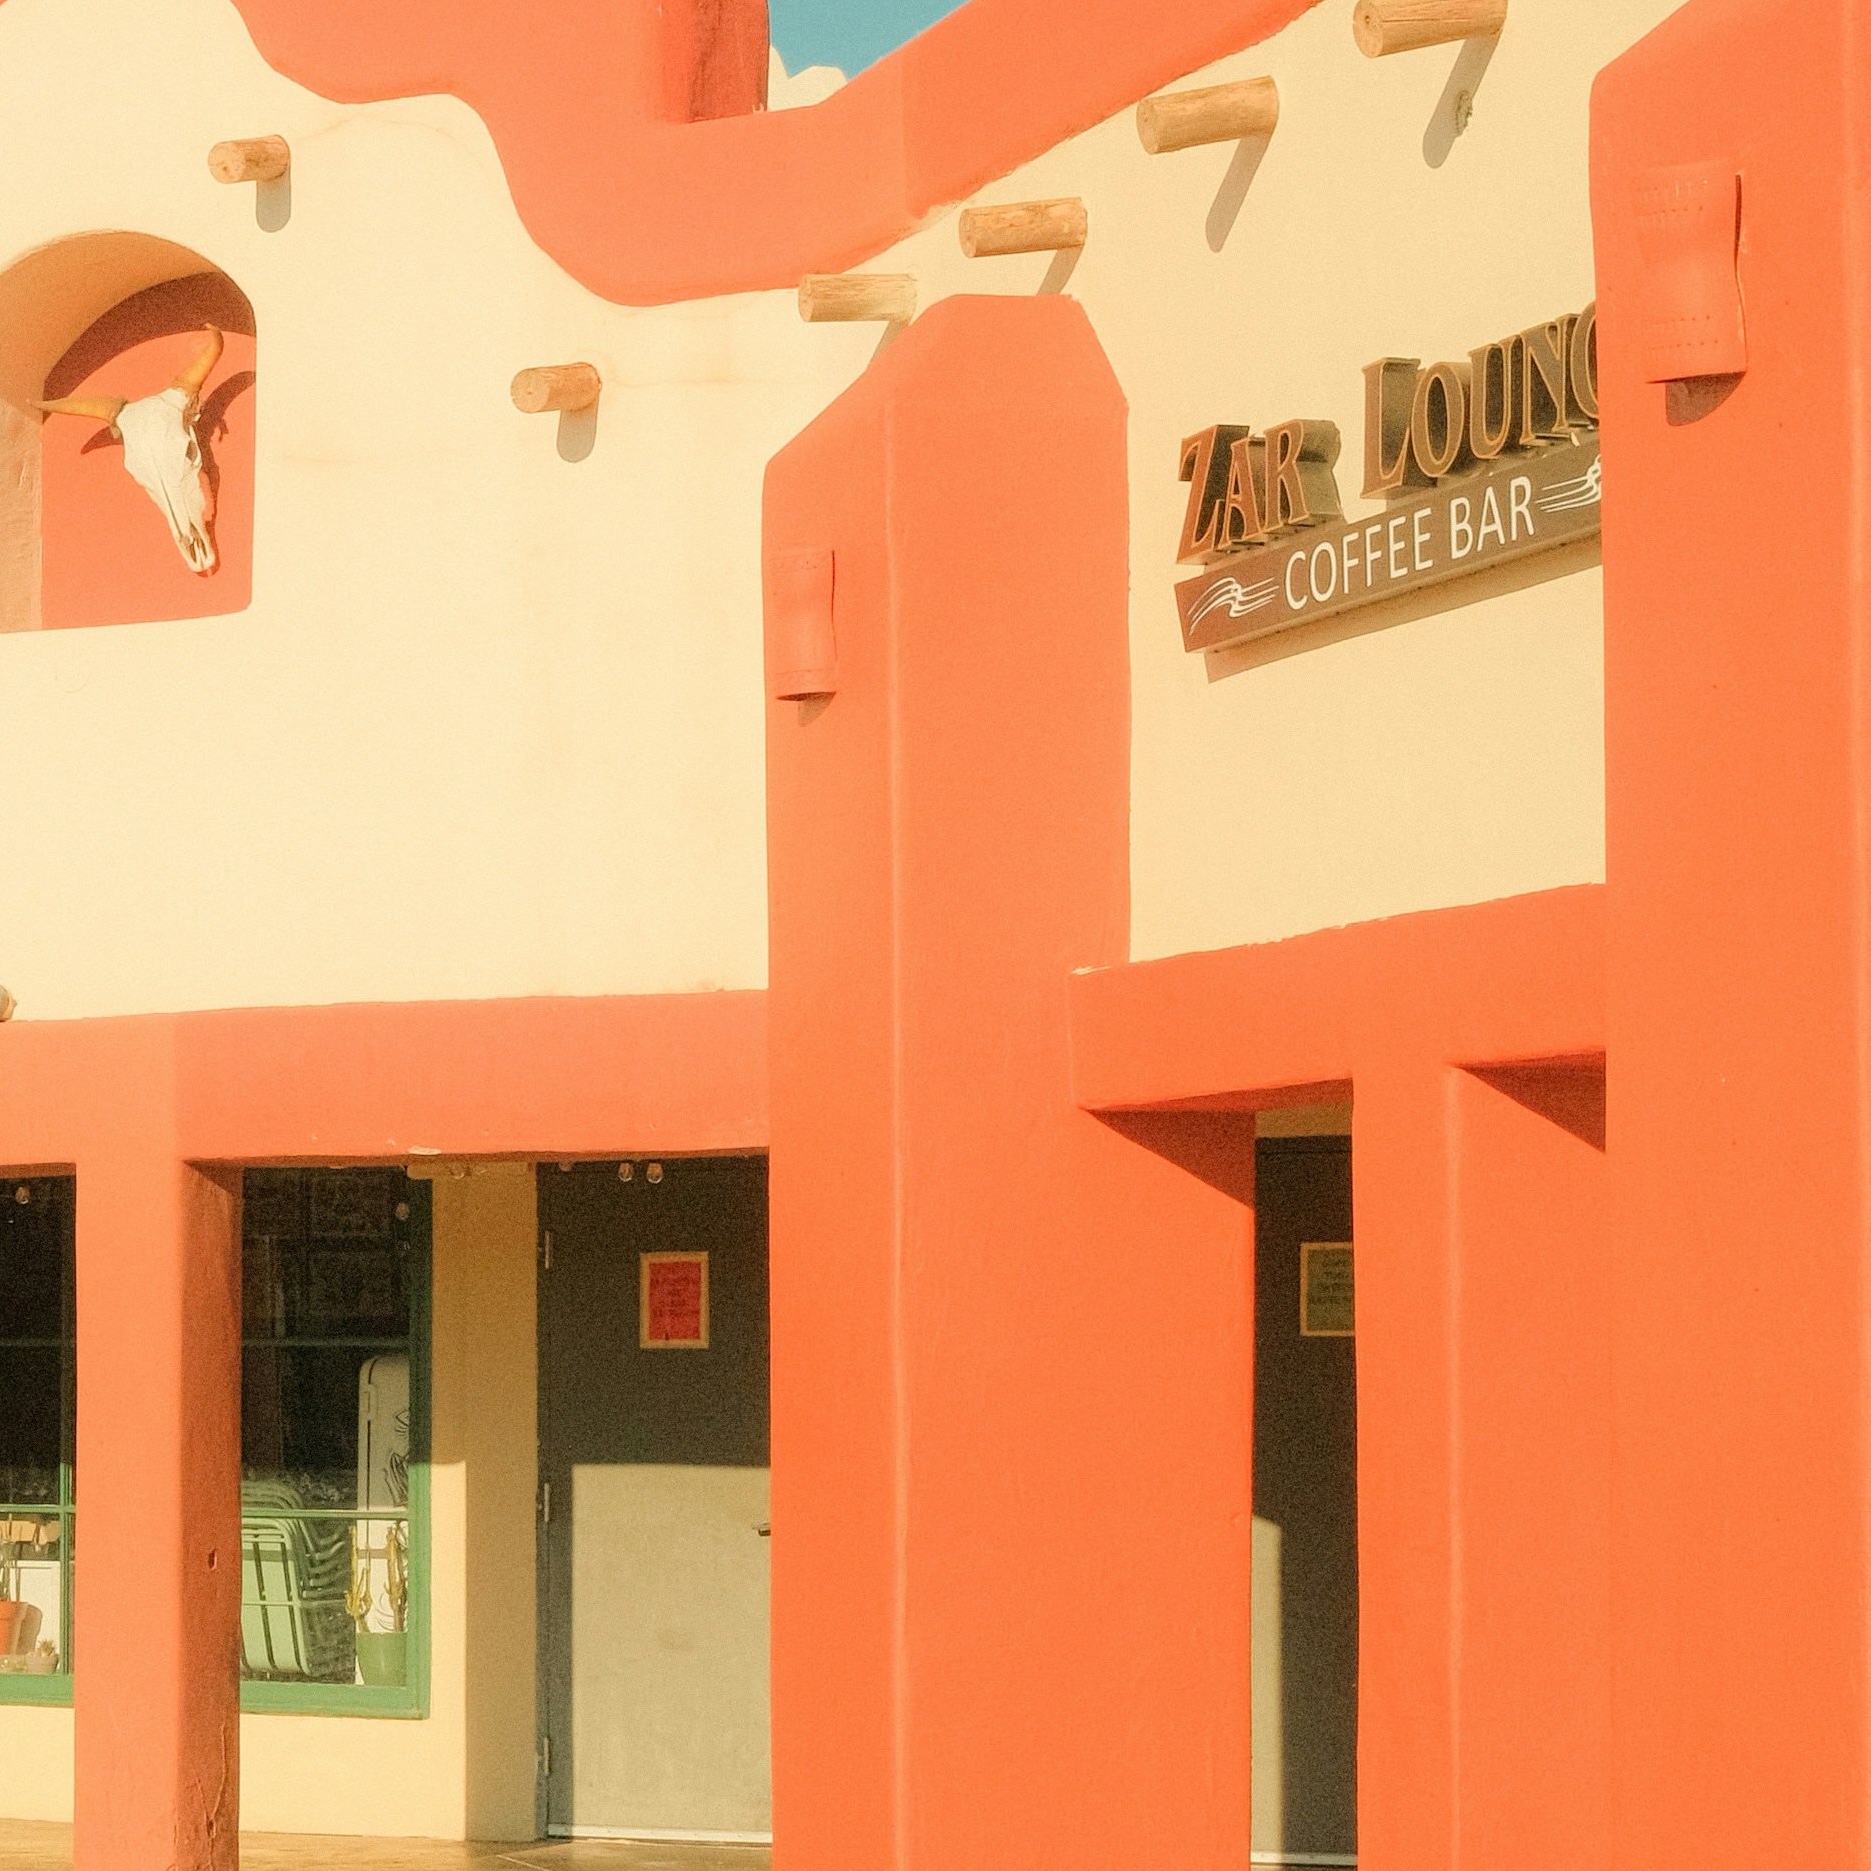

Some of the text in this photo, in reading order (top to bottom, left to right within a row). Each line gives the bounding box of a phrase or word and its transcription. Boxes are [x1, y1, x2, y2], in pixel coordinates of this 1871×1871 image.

[1176, 419, 1345, 565] ZAR
[1283, 475, 1535, 611] COFFEE BAR
